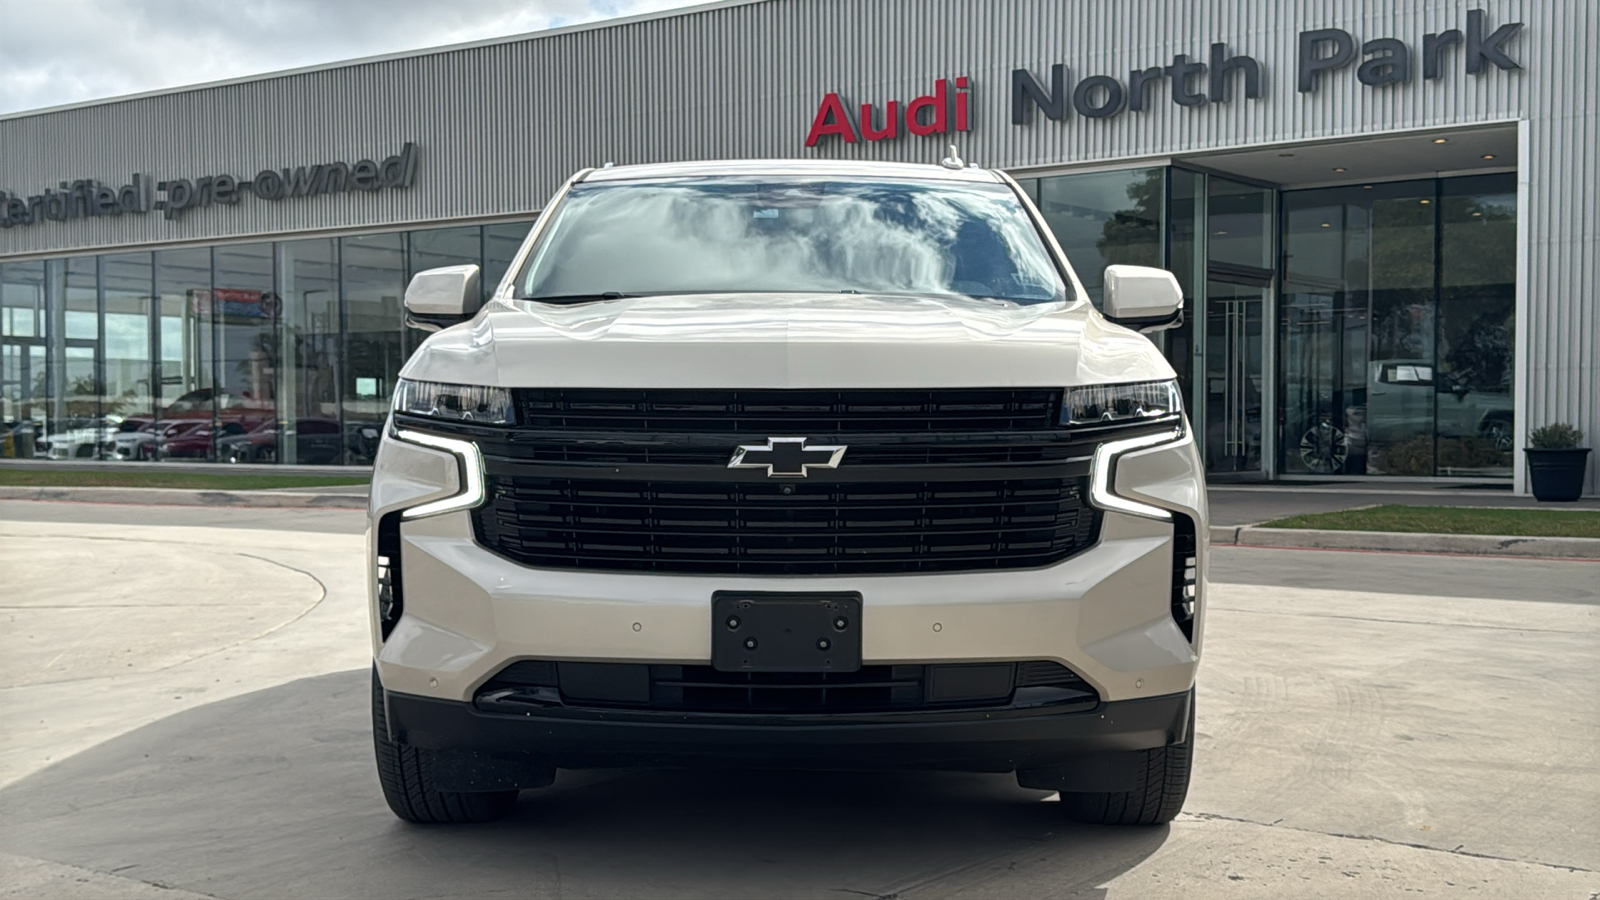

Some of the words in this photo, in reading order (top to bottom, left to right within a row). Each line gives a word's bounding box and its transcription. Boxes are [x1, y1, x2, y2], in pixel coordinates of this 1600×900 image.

[805, 76, 972, 146] Audi
[1012, 42, 1261, 126] North
[1298, 9, 1524, 93] Park
